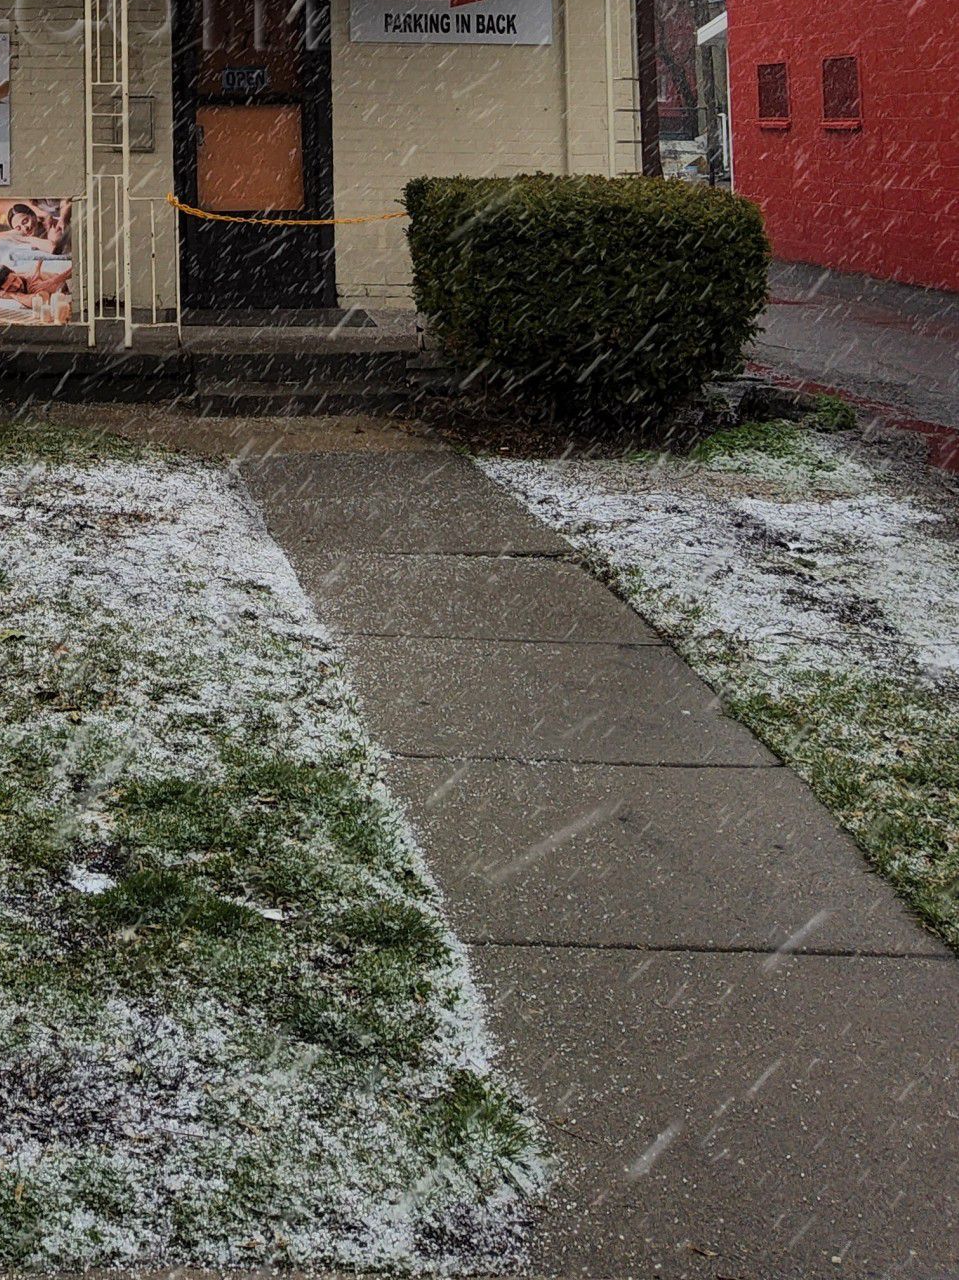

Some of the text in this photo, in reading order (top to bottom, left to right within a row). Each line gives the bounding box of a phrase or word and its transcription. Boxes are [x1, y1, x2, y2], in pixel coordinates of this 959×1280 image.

[384, 13, 517, 34] PARKING IN BACK
[225, 70, 265, 87] OPEN
